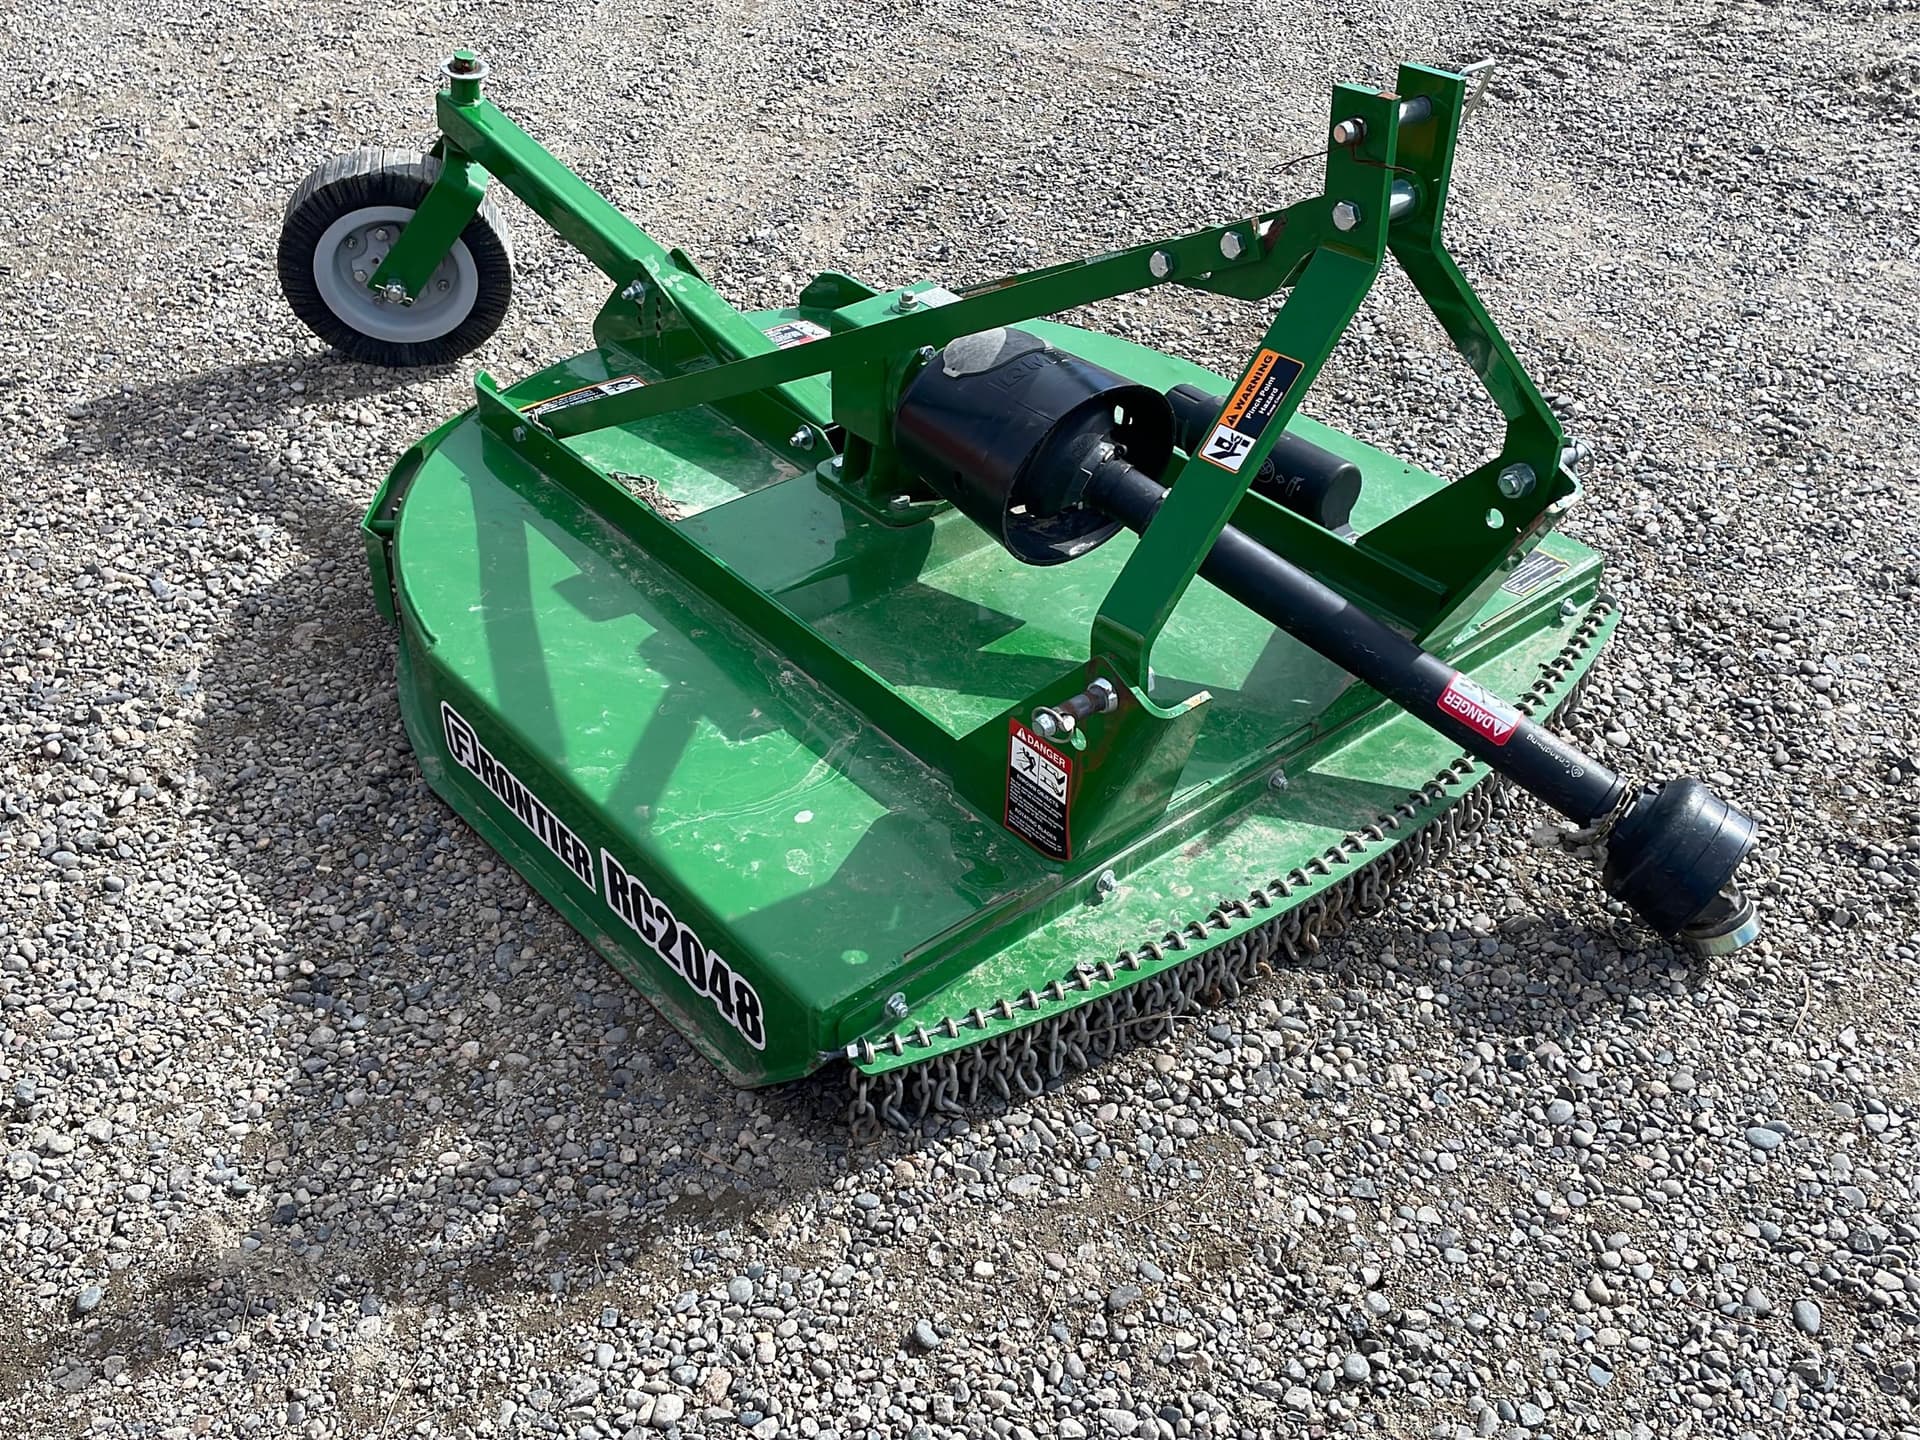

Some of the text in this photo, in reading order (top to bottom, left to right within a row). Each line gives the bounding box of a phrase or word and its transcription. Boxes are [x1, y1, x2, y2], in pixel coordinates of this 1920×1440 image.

[1235, 354, 1273, 411] WARNING
[1245, 376, 1276, 419] Pinch Point
[1258, 387, 1279, 414] Hazard
[1443, 690, 1494, 729] DANGER
[1027, 734, 1066, 768] DANGER
[603, 848, 766, 1050] RC2048
